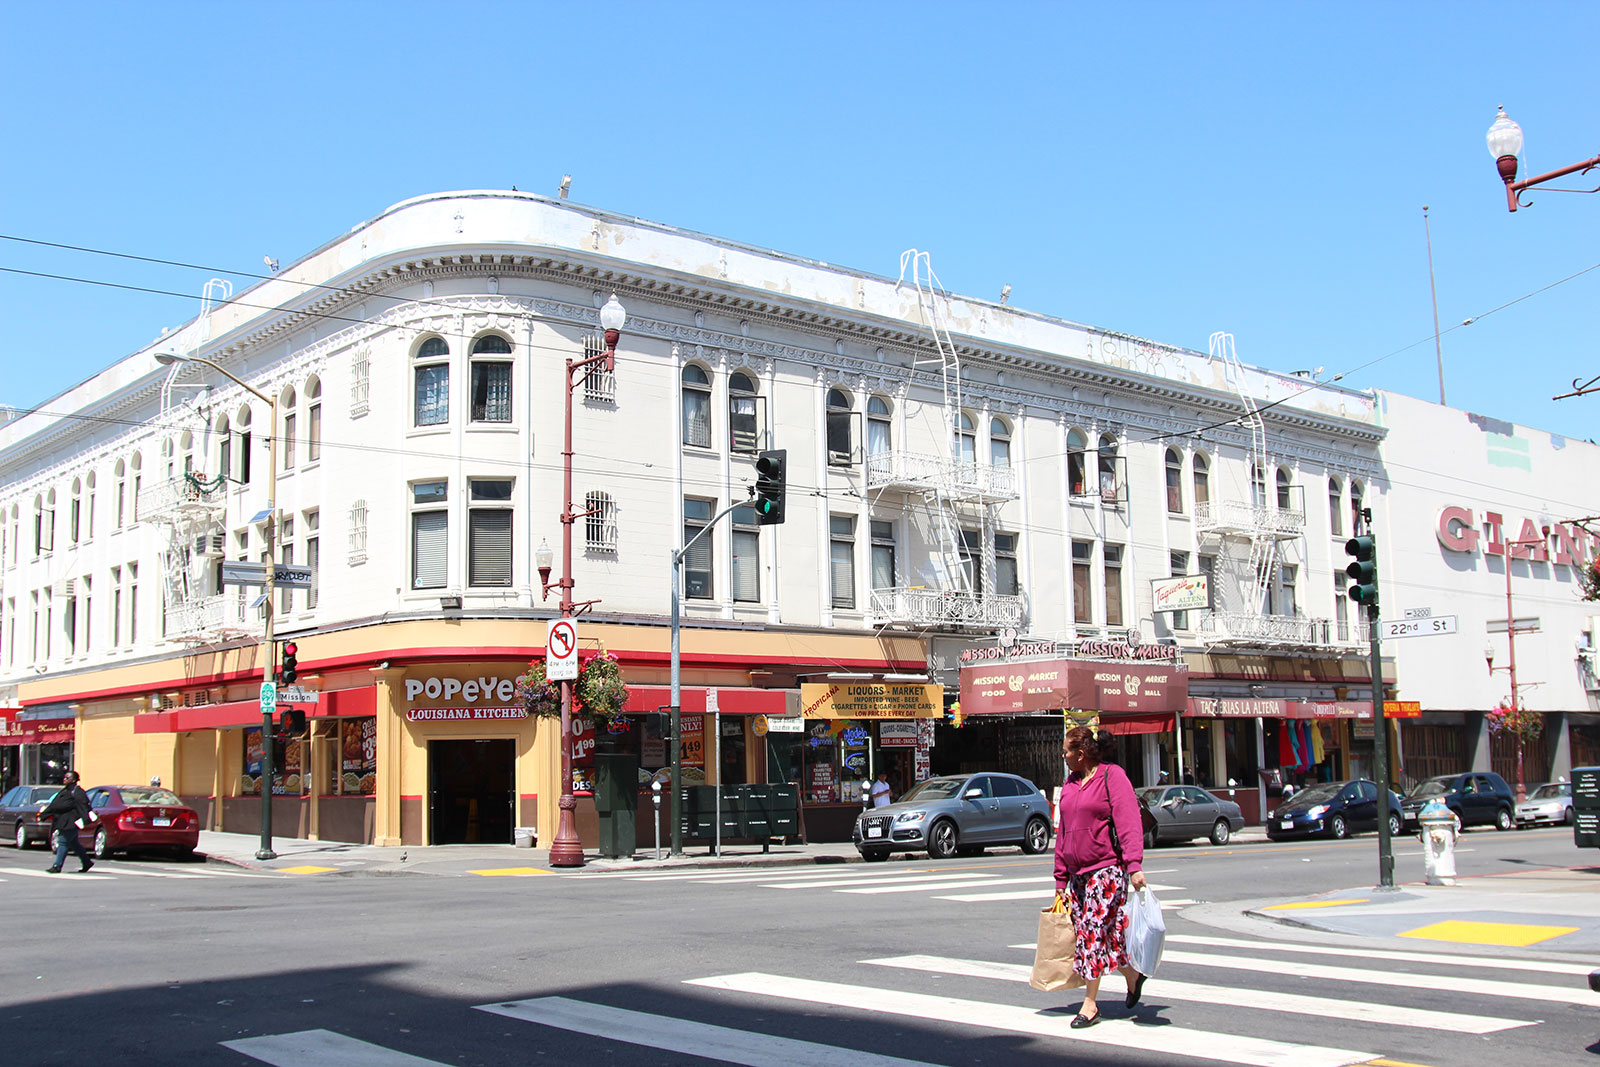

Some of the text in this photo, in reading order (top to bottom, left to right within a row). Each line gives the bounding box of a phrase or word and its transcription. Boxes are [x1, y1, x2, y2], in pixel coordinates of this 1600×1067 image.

[1390, 620, 1447, 635] 22nd St
[960, 642, 1055, 661] MISSION MARKET
[1079, 641, 1130, 656] MISSION
[973, 672, 1059, 685] MISSION MARKET
[1094, 673, 1121, 681] MISSION
[848, 686, 884, 695] LIQUORS
[892, 686, 924, 695] MARKET
[804, 686, 840, 717] TROPICANA
[1242, 701, 1249, 714] LA
[1254, 701, 1280, 714] ALTEÑA
[1384, 703, 1400, 712] OYERIA
[410, 708, 526, 720] LOUISIANA KITCHEN
[607, 722, 630, 732] OPEN
[680, 722, 702, 732] NLY!
